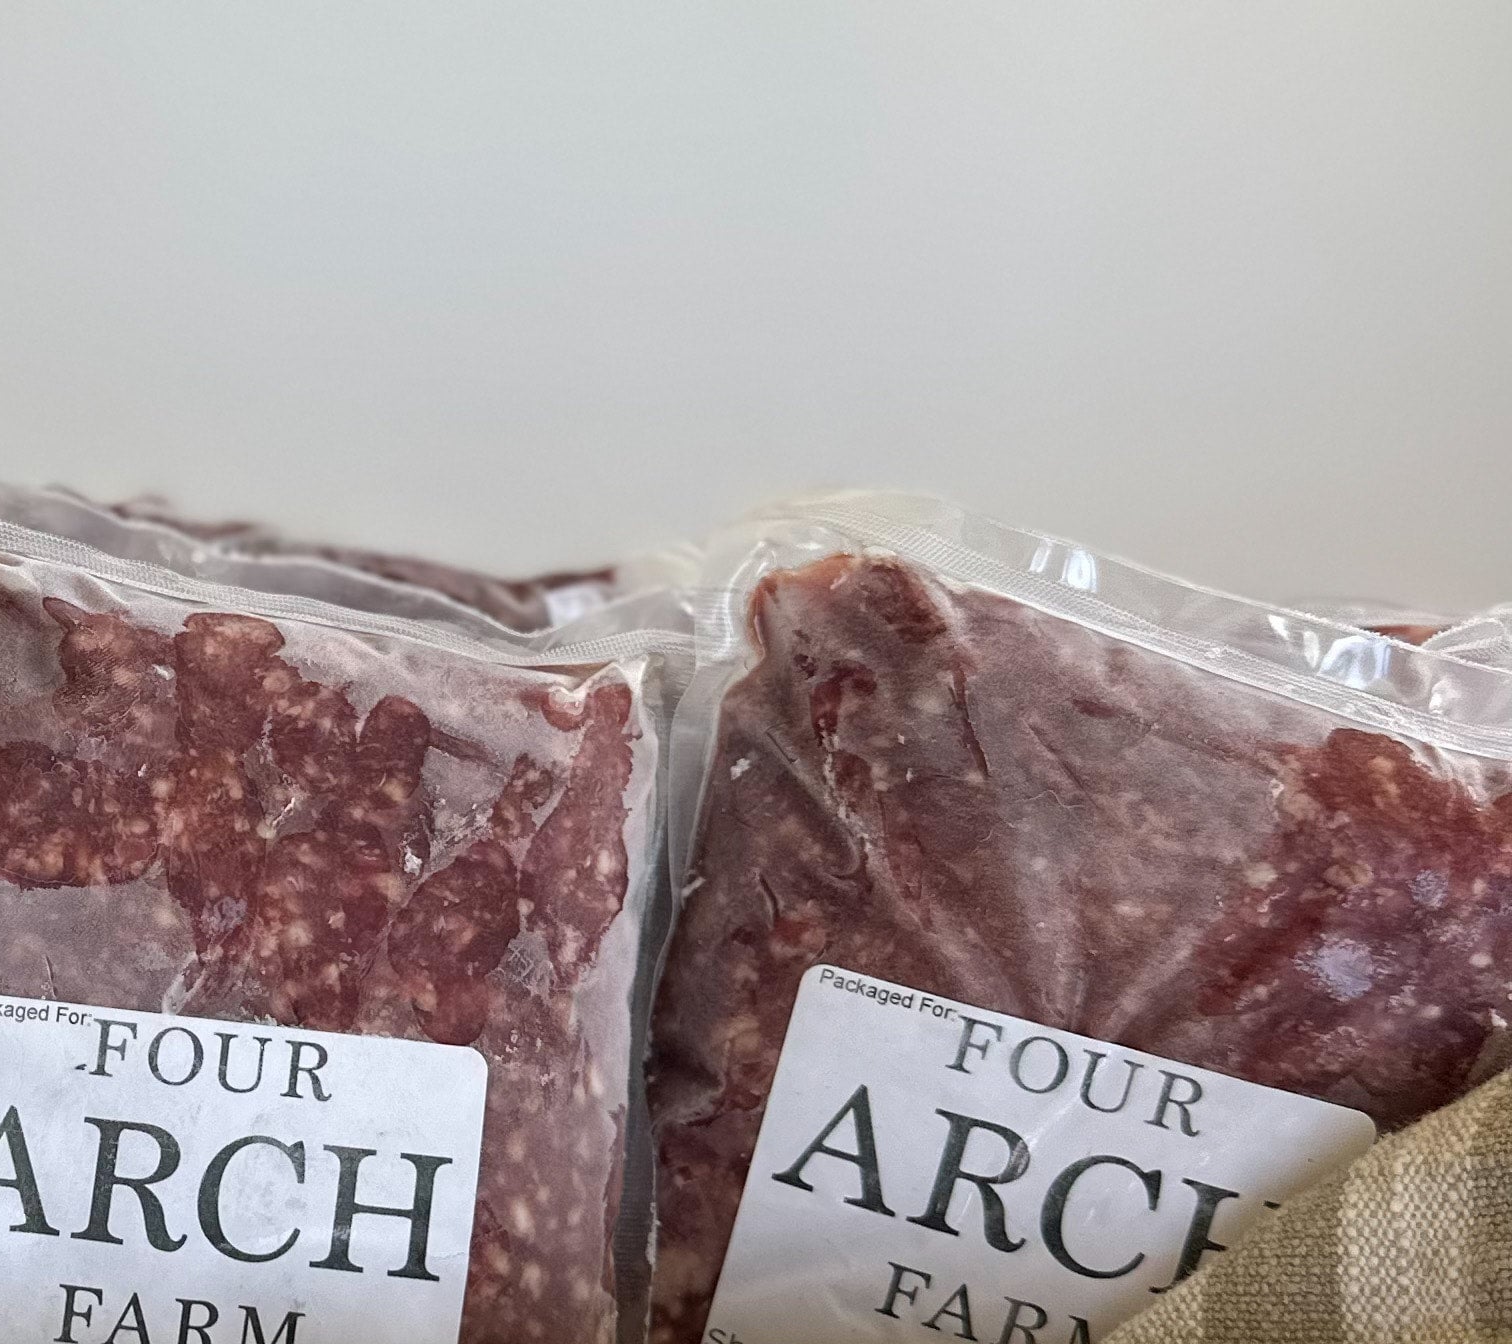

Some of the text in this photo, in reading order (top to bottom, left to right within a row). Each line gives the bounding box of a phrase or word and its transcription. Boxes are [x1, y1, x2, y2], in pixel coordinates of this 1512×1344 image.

[55, 1006, 93, 1027] For:
[819, 968, 915, 1010] Packaged
[89, 1017, 333, 1102] FOUR
[944, 1015, 1205, 1138] FOUR
